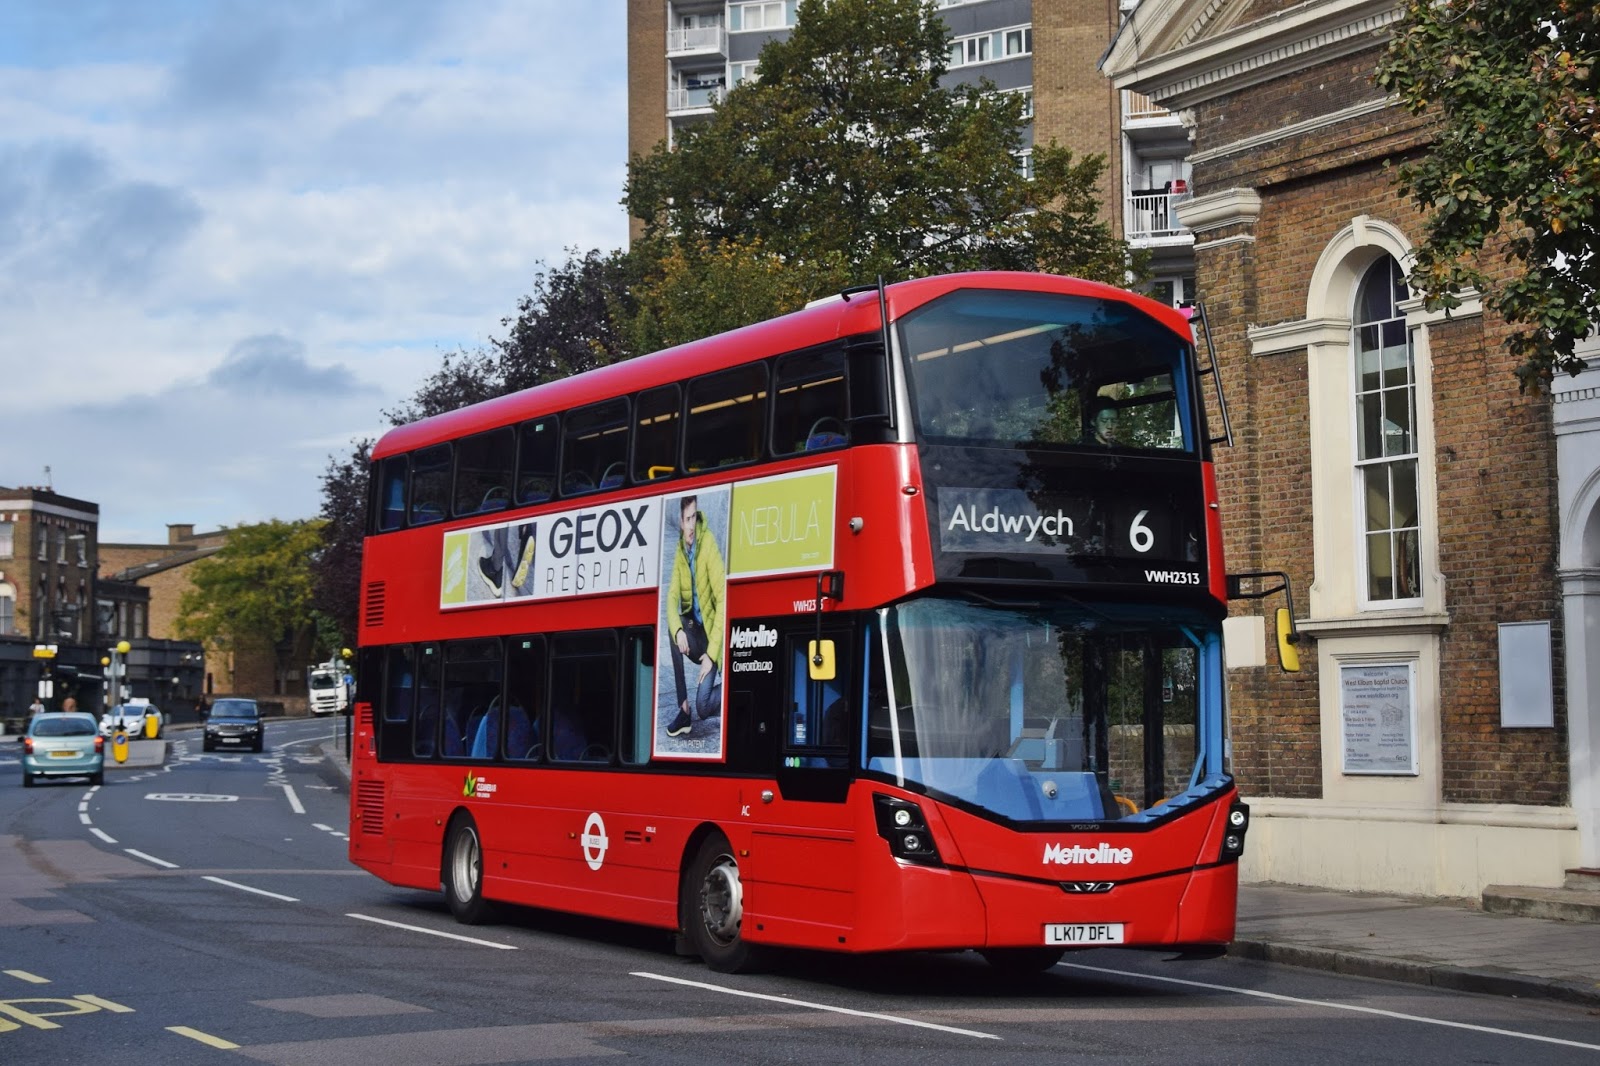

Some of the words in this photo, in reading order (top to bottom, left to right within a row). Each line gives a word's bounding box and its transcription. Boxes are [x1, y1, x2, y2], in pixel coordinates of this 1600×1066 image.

[549, 505, 649, 558] GEOX
[740, 500, 820, 546] NEBULA
[948, 504, 1073, 542] Aldwych
[1129, 510, 1154, 552] 6
[546, 557, 646, 593] RESPIRA
[1145, 570, 1200, 584] VWH2313
[730, 624, 778, 649] Metroline
[741, 805, 750, 816] AC
[1042, 842, 1133, 865] Metroline
[1054, 926, 1085, 942] LK17
[1088, 926, 1115, 941] DFL
